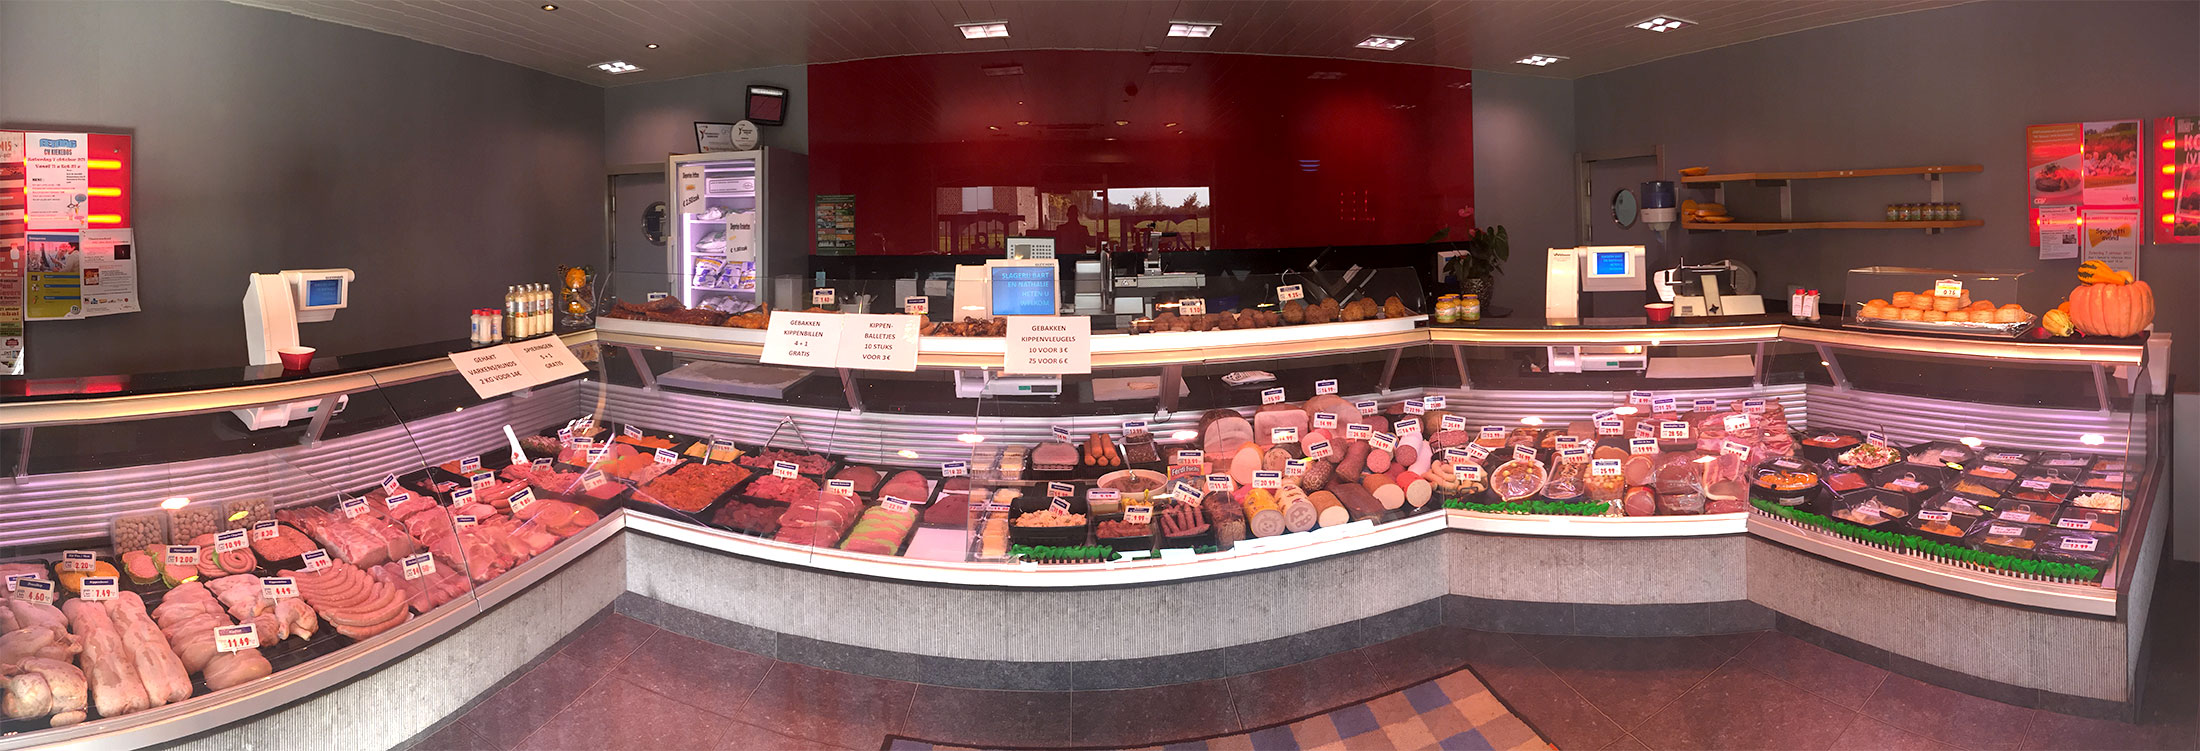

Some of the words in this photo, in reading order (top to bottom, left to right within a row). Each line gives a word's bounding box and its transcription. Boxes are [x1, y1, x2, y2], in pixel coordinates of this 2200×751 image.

[790, 319, 820, 327] GEBAKKEN
[784, 330, 823, 338] KIPPENBILLEN
[523, 343, 554, 353] SPIERINGEN
[473, 354, 497, 363] GEHAKT
[468, 360, 518, 376] VARKENS/RUNDS
[545, 360, 564, 369] GRATIS
[495, 372, 512, 382] VOOR
[28, 591, 46, 601] 4.60
[95, 589, 111, 598] 7.49
[228, 637, 250, 648] 11.49
